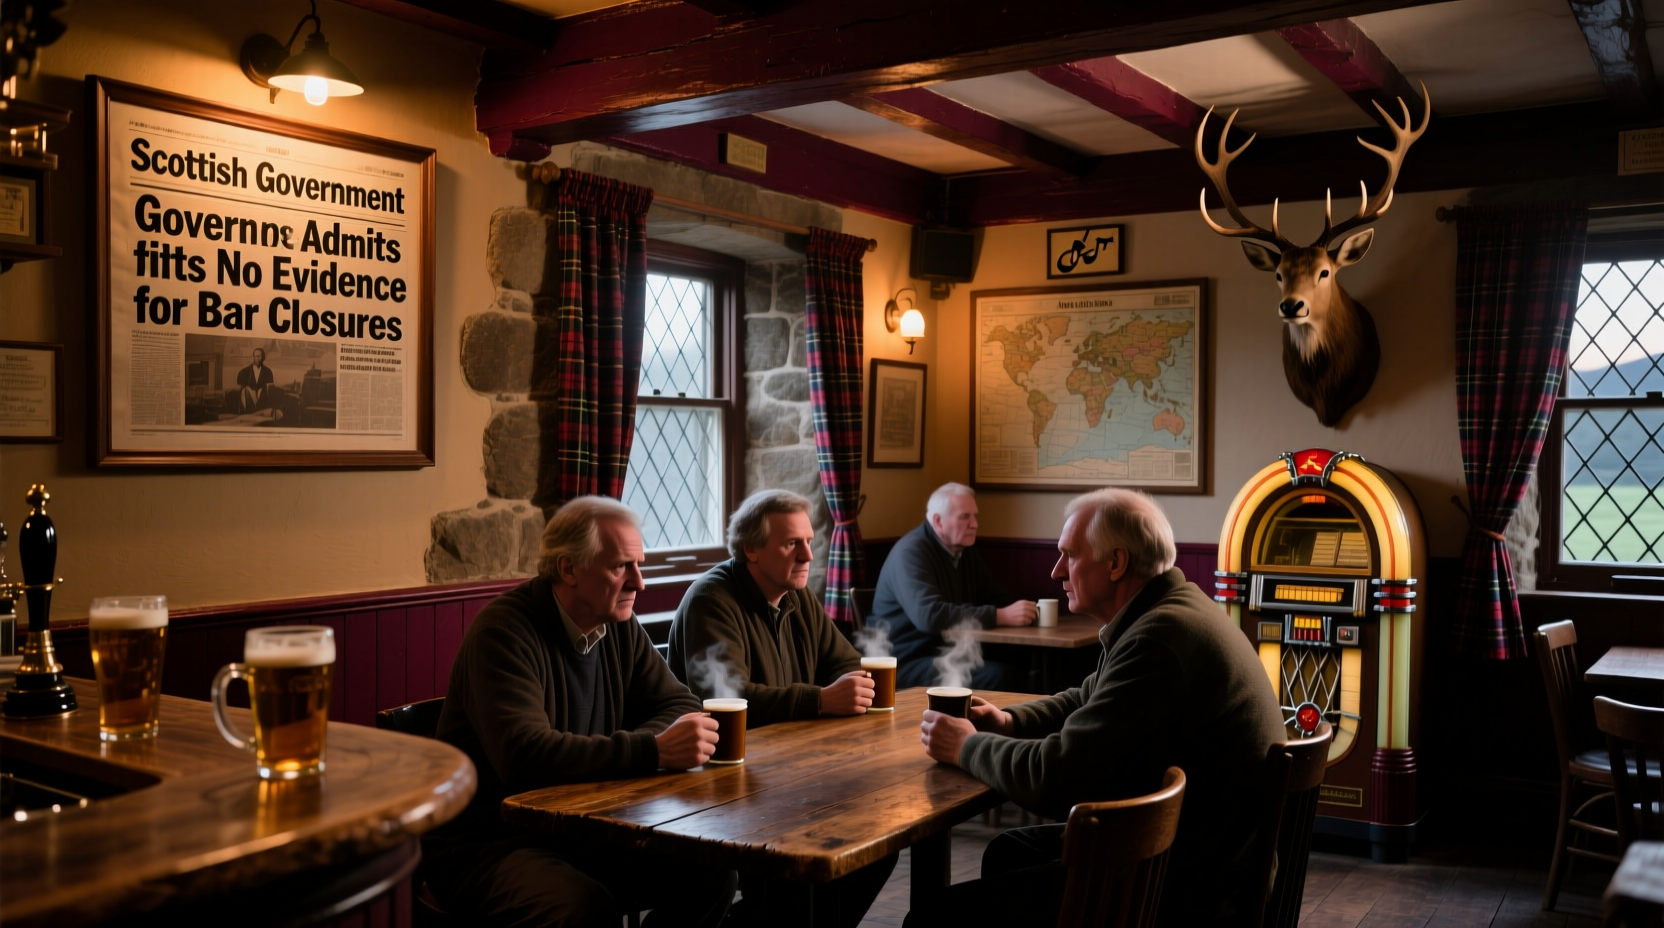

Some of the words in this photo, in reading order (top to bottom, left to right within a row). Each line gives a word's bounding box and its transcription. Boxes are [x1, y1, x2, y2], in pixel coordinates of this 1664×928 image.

[131, 138, 247, 188] Scottish
[256, 162, 405, 214] Government
[301, 220, 401, 263] Admits
[217, 249, 262, 288] No
[272, 256, 406, 302] Evidence
[133, 286, 188, 325] for
[198, 291, 259, 330] Bar
[268, 297, 402, 341] Closures
